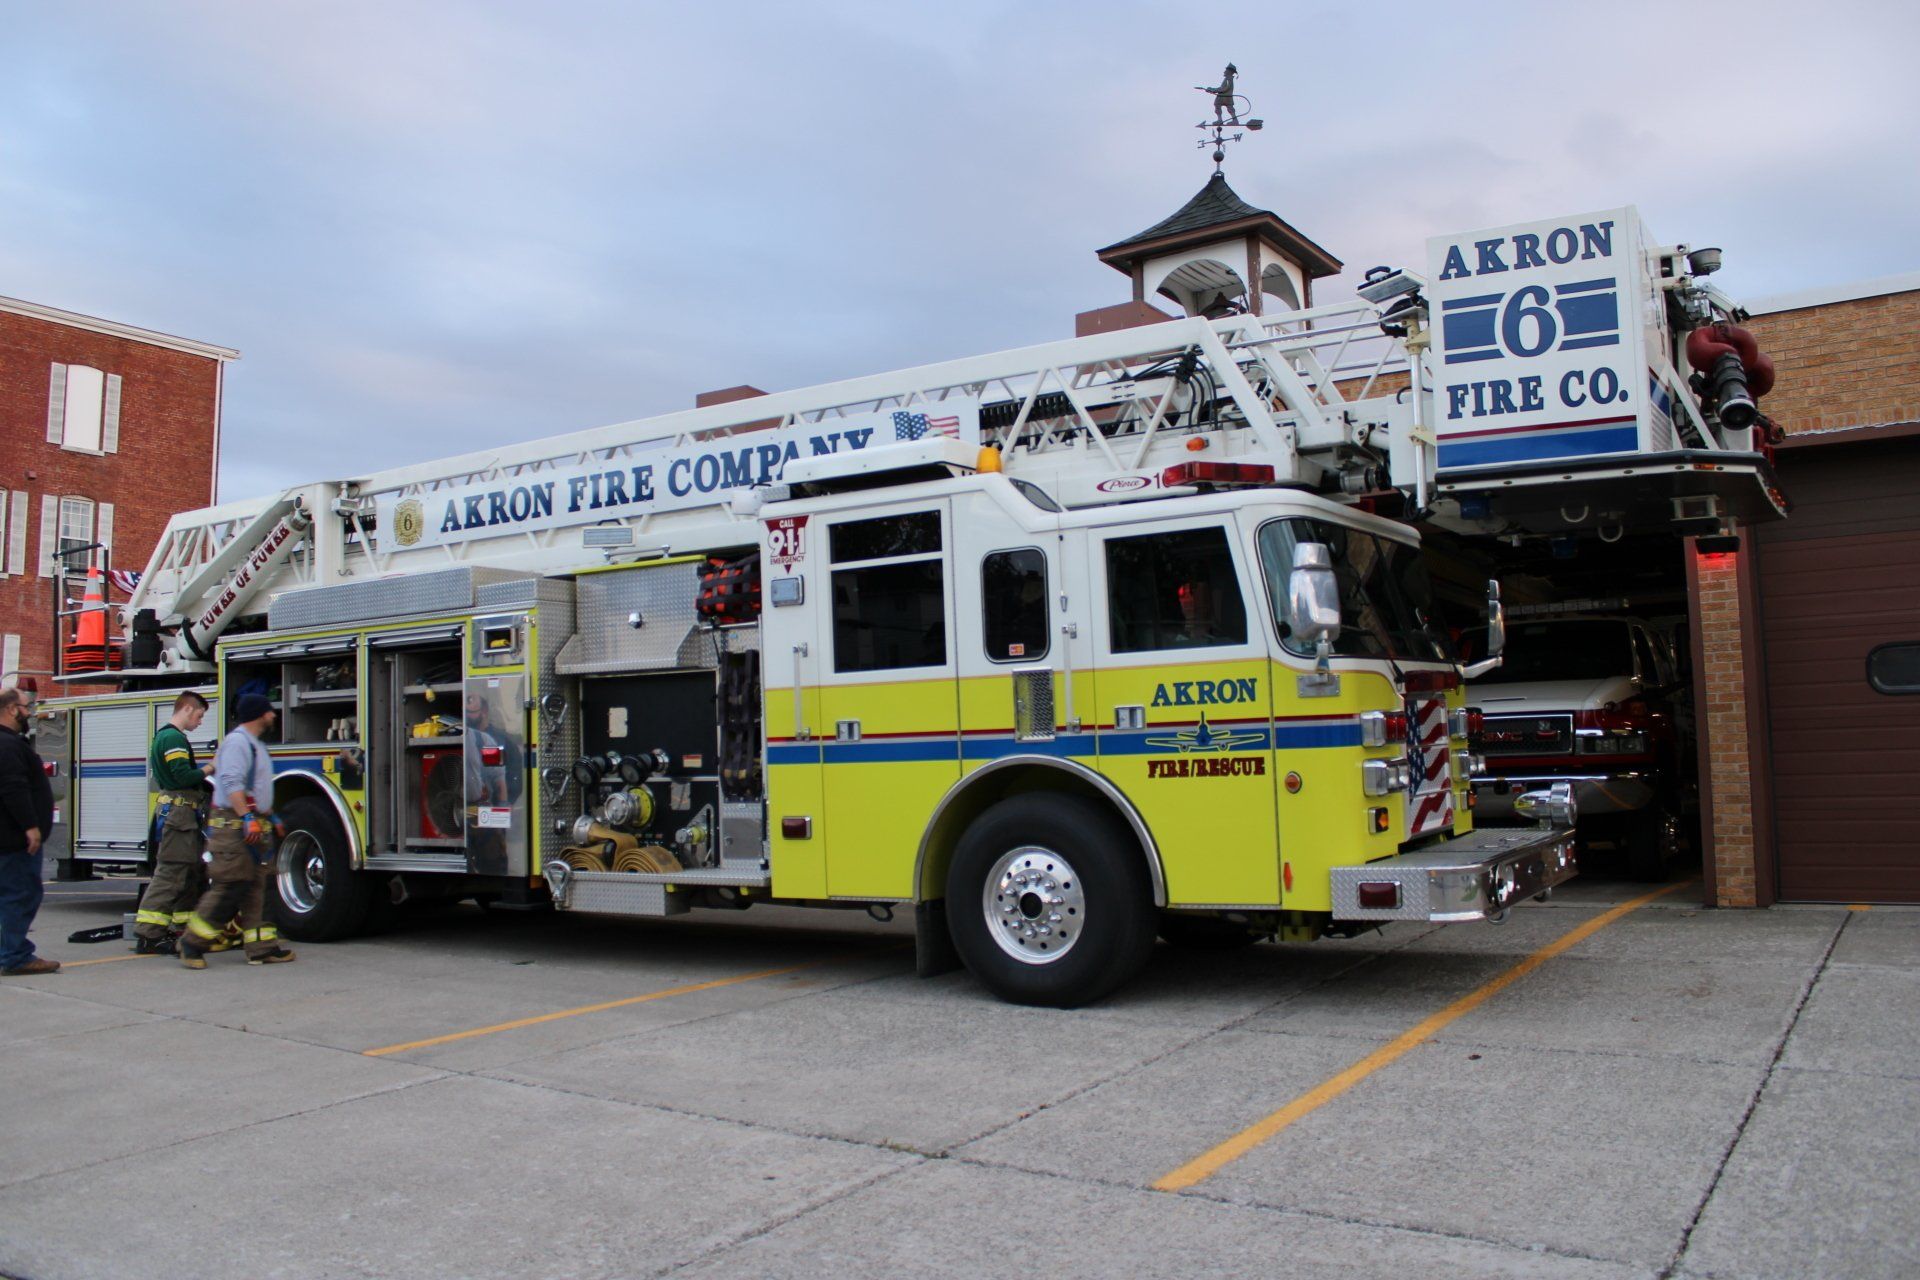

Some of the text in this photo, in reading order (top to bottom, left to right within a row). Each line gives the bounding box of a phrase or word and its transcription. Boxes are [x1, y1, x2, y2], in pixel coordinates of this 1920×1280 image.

[1439, 221, 1614, 281] AKRON
[1502, 285, 1557, 358] 6
[1446, 367, 1629, 420] FIRE CO.
[440, 482, 555, 533] AKRON
[568, 465, 654, 513] FIRE
[1109, 480, 1140, 490] Pierce
[404, 513, 413, 531] 6
[779, 519, 795, 529] CALL
[770, 555, 804, 565] EMERGENCY
[200, 526, 290, 630] TOWER OF POWER
[1151, 678, 1258, 707] AKRON
[1147, 757, 1266, 778] FIRE/RESCUE
